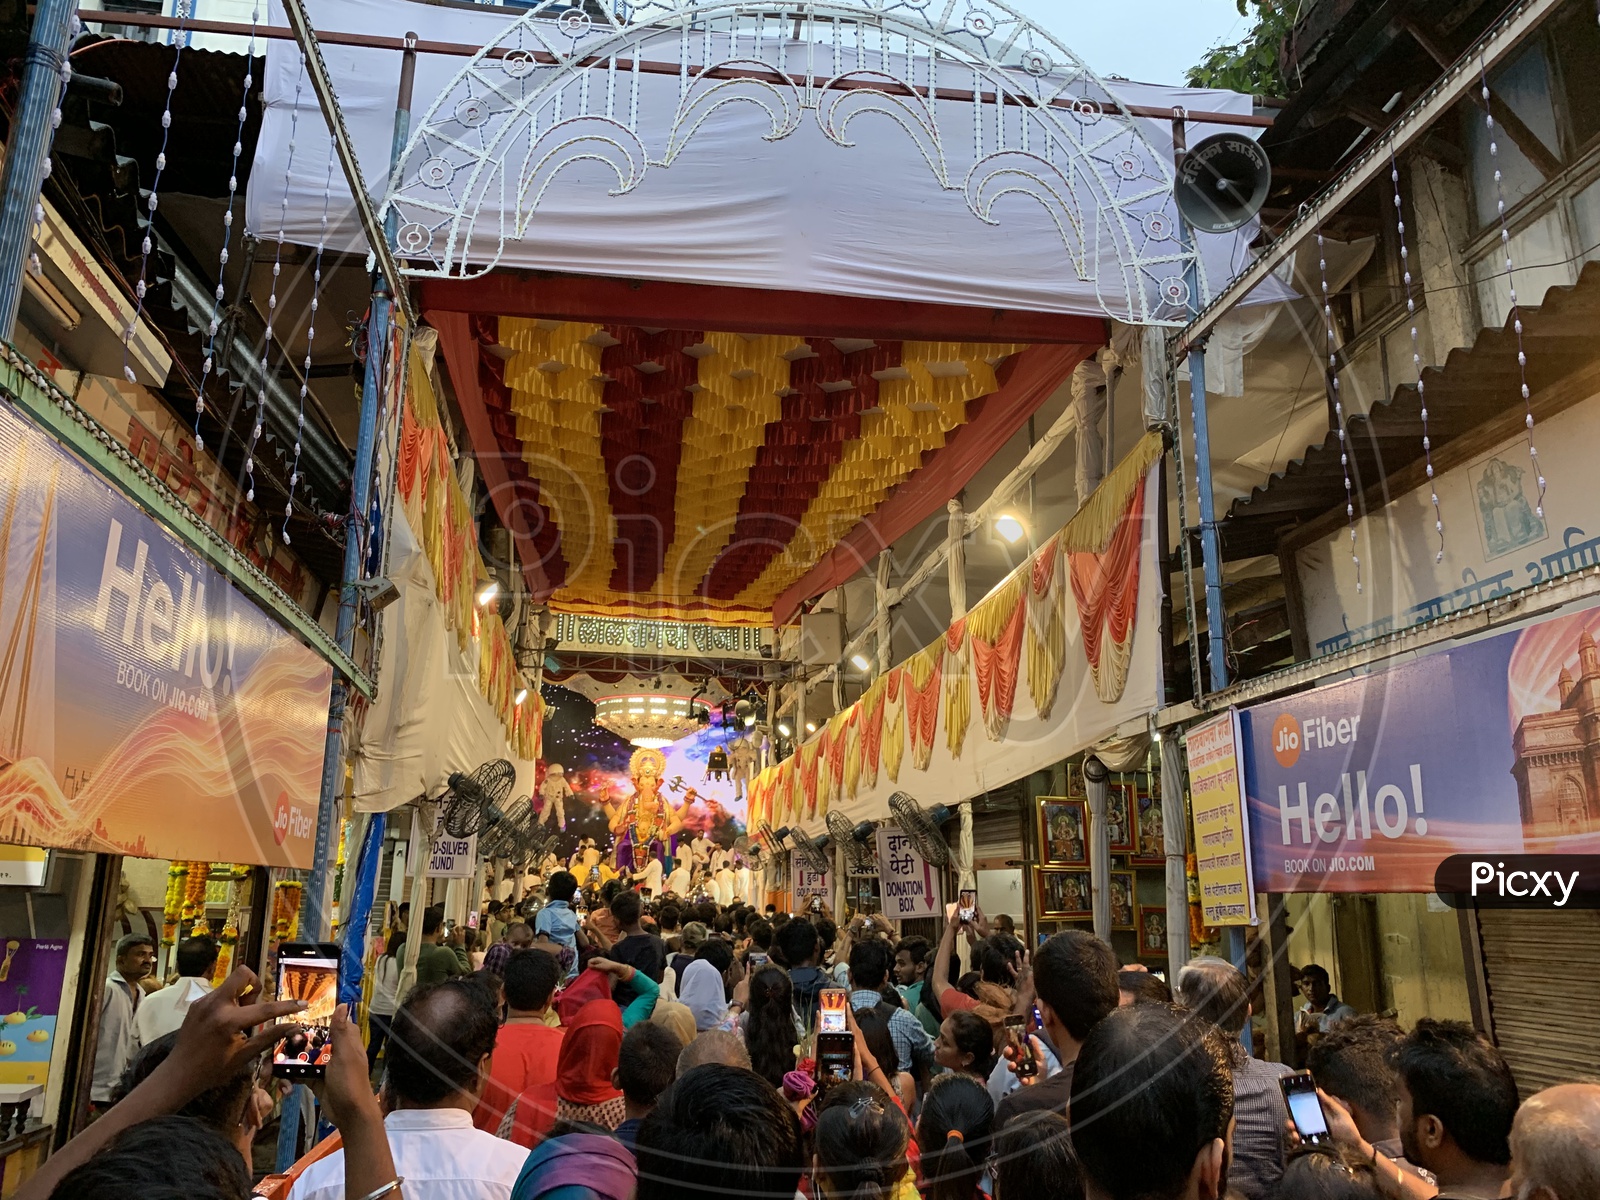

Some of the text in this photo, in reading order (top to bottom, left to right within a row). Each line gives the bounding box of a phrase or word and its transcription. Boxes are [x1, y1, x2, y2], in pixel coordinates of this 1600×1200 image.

[94, 518, 240, 696] Hello!
[691, 622, 741, 652] राजा
[117, 661, 209, 721] BOOK ON JIO.COM
[1276, 714, 1360, 752] Jio Fiber
[1278, 763, 1428, 845] Hello!
[275, 805, 313, 839] Jio Fiber
[433, 841, 468, 855] D-SILVER
[429, 856, 454, 870] HUNDI
[889, 853, 914, 875] पेटी
[1284, 855, 1375, 874] BOOK ON JIO.COM
[886, 880, 923, 897] DONATION
[899, 897, 916, 912] BOX
